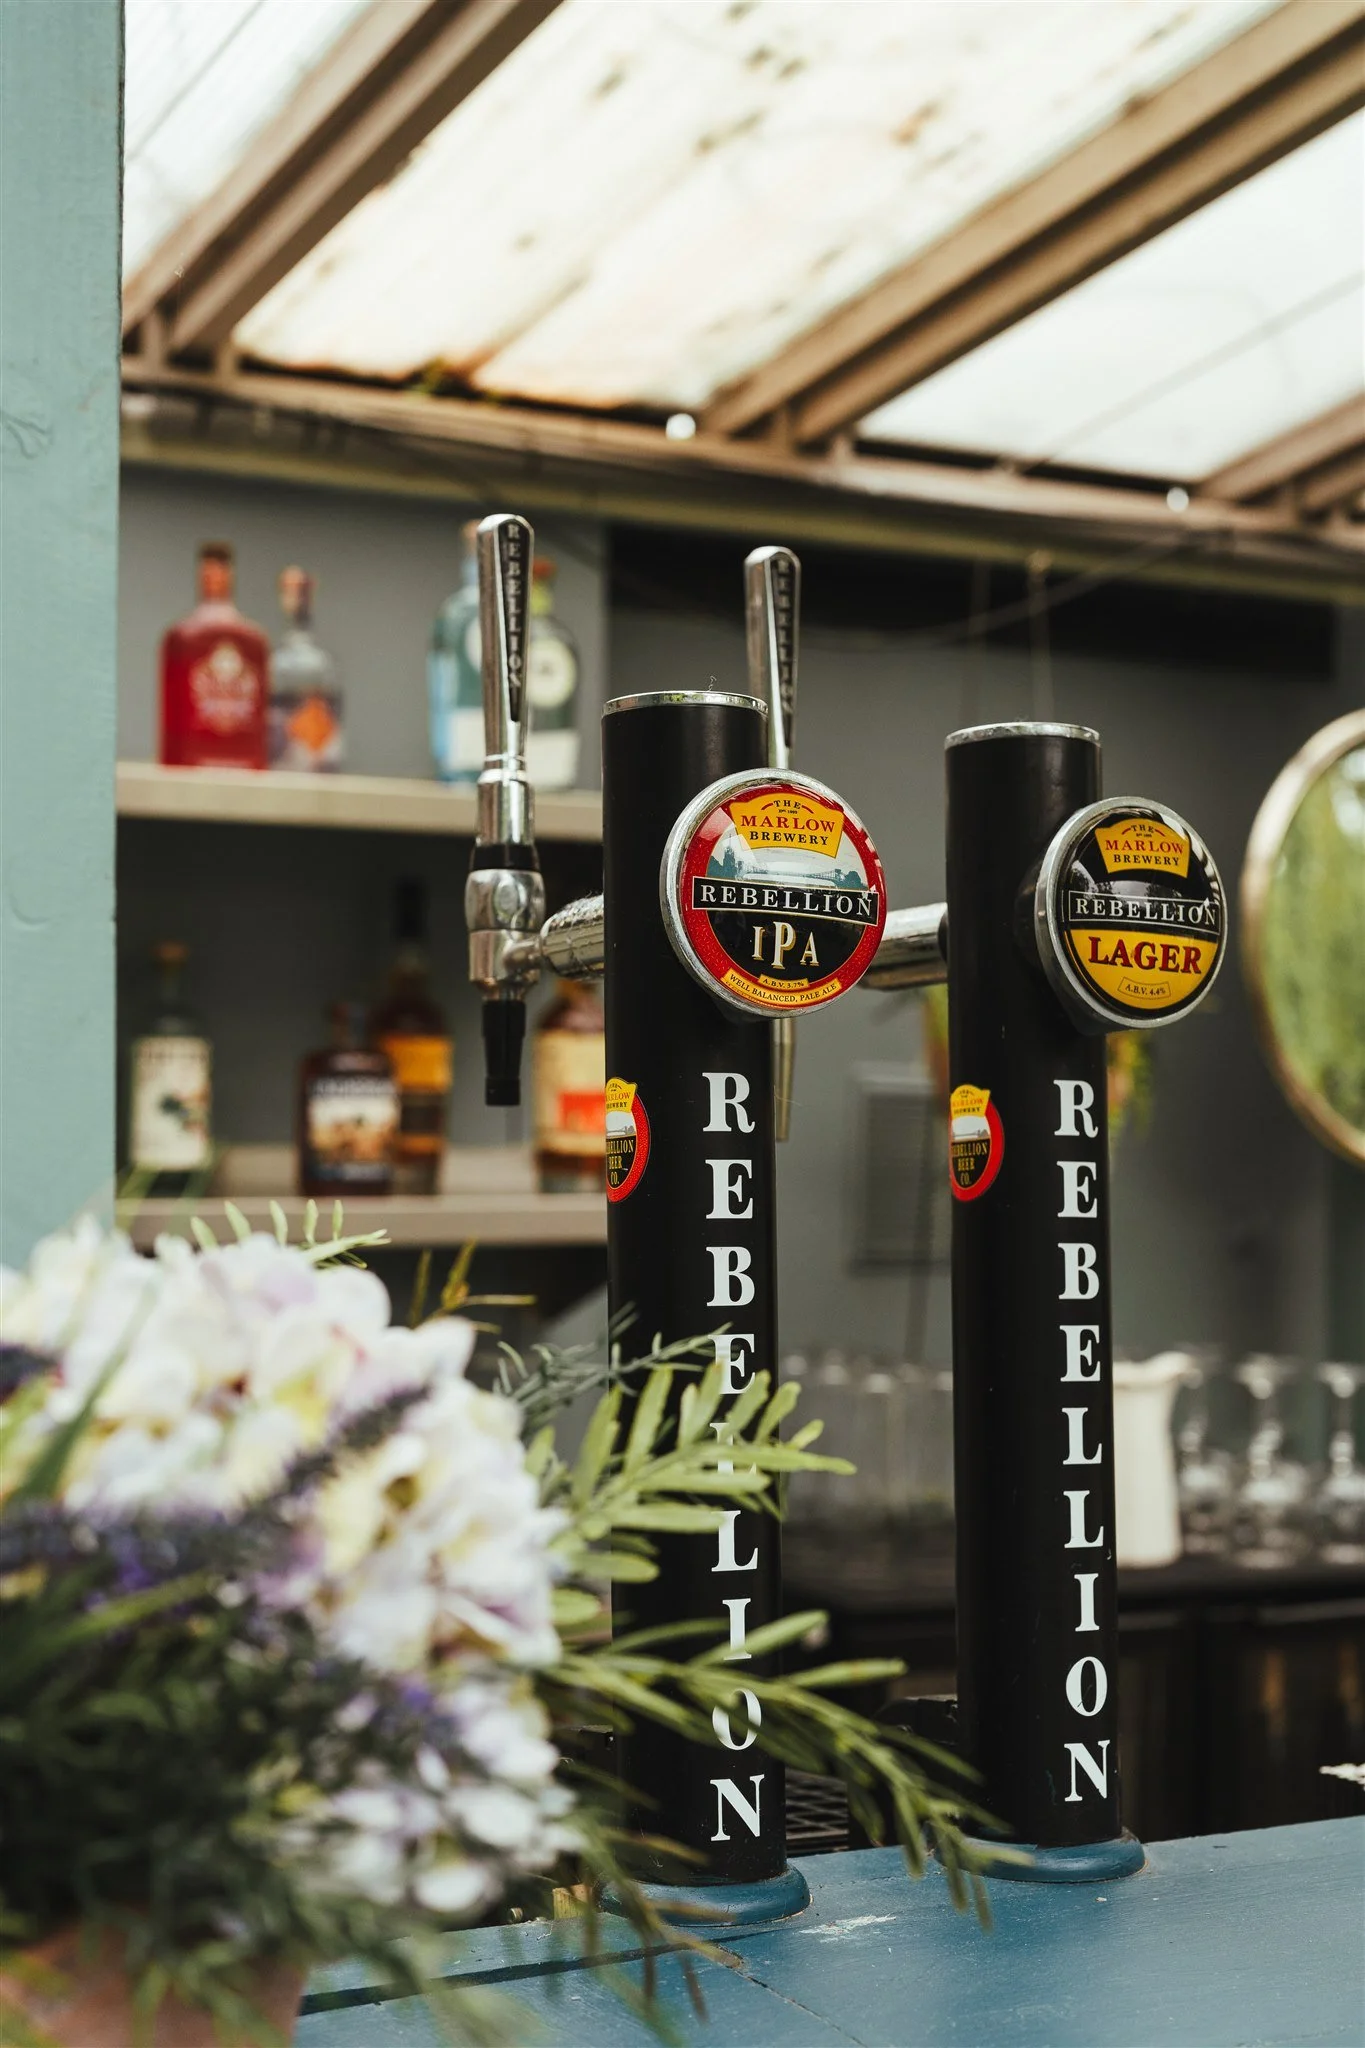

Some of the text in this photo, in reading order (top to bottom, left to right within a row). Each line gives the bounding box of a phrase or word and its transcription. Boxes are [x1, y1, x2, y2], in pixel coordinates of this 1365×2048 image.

[507, 522, 522, 688] REBELLION
[774, 800, 801, 809] THE
[741, 815, 835, 833] MARLOW
[1131, 824, 1154, 833] THE
[750, 831, 829, 845] BREWERY
[1105, 840, 1184, 854] MARLOW
[1113, 854, 1179, 866] BREWERY
[700, 884, 872, 917] REBELLION
[1075, 898, 1217, 925] REBELLION
[752, 921, 819, 970] IPA
[1088, 936, 1202, 974] LAGER
[730, 974, 837, 1003] WELL BALANCED, PALE ALE
[1053, 1079, 1110, 1802] REBELLION
